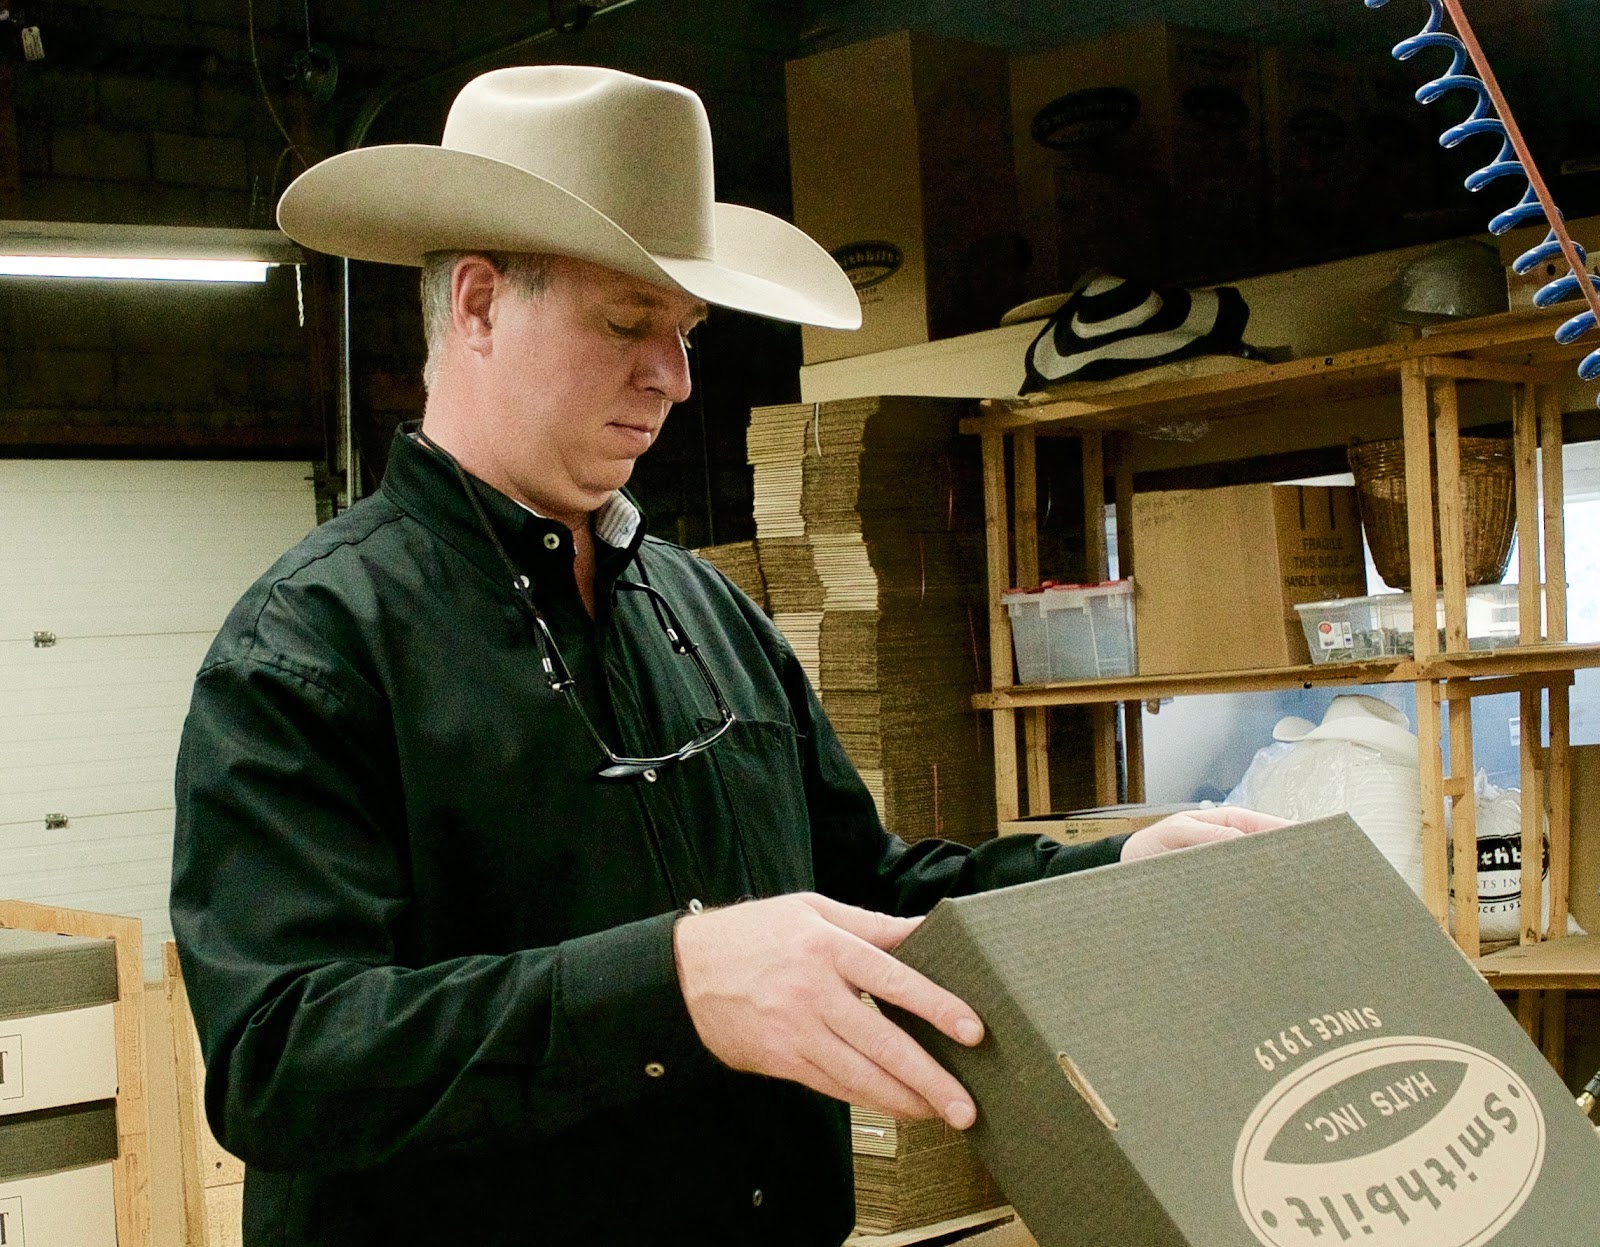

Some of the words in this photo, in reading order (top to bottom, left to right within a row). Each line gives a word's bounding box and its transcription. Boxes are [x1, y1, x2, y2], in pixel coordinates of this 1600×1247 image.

[1294, 556, 1316, 569] THIS
[1318, 555, 1341, 568] SIDE
[1303, 538, 1344, 550] FRAGILE
[1285, 575, 1317, 587] HANDLE
[1308, 1006, 1383, 1042] SINCE
[1254, 1025, 1313, 1072] 1919
[1370, 1071, 1438, 1117] HATS
[1304, 1103, 1368, 1143] INC.
[1285, 1091, 1519, 1242] Smithbilt
